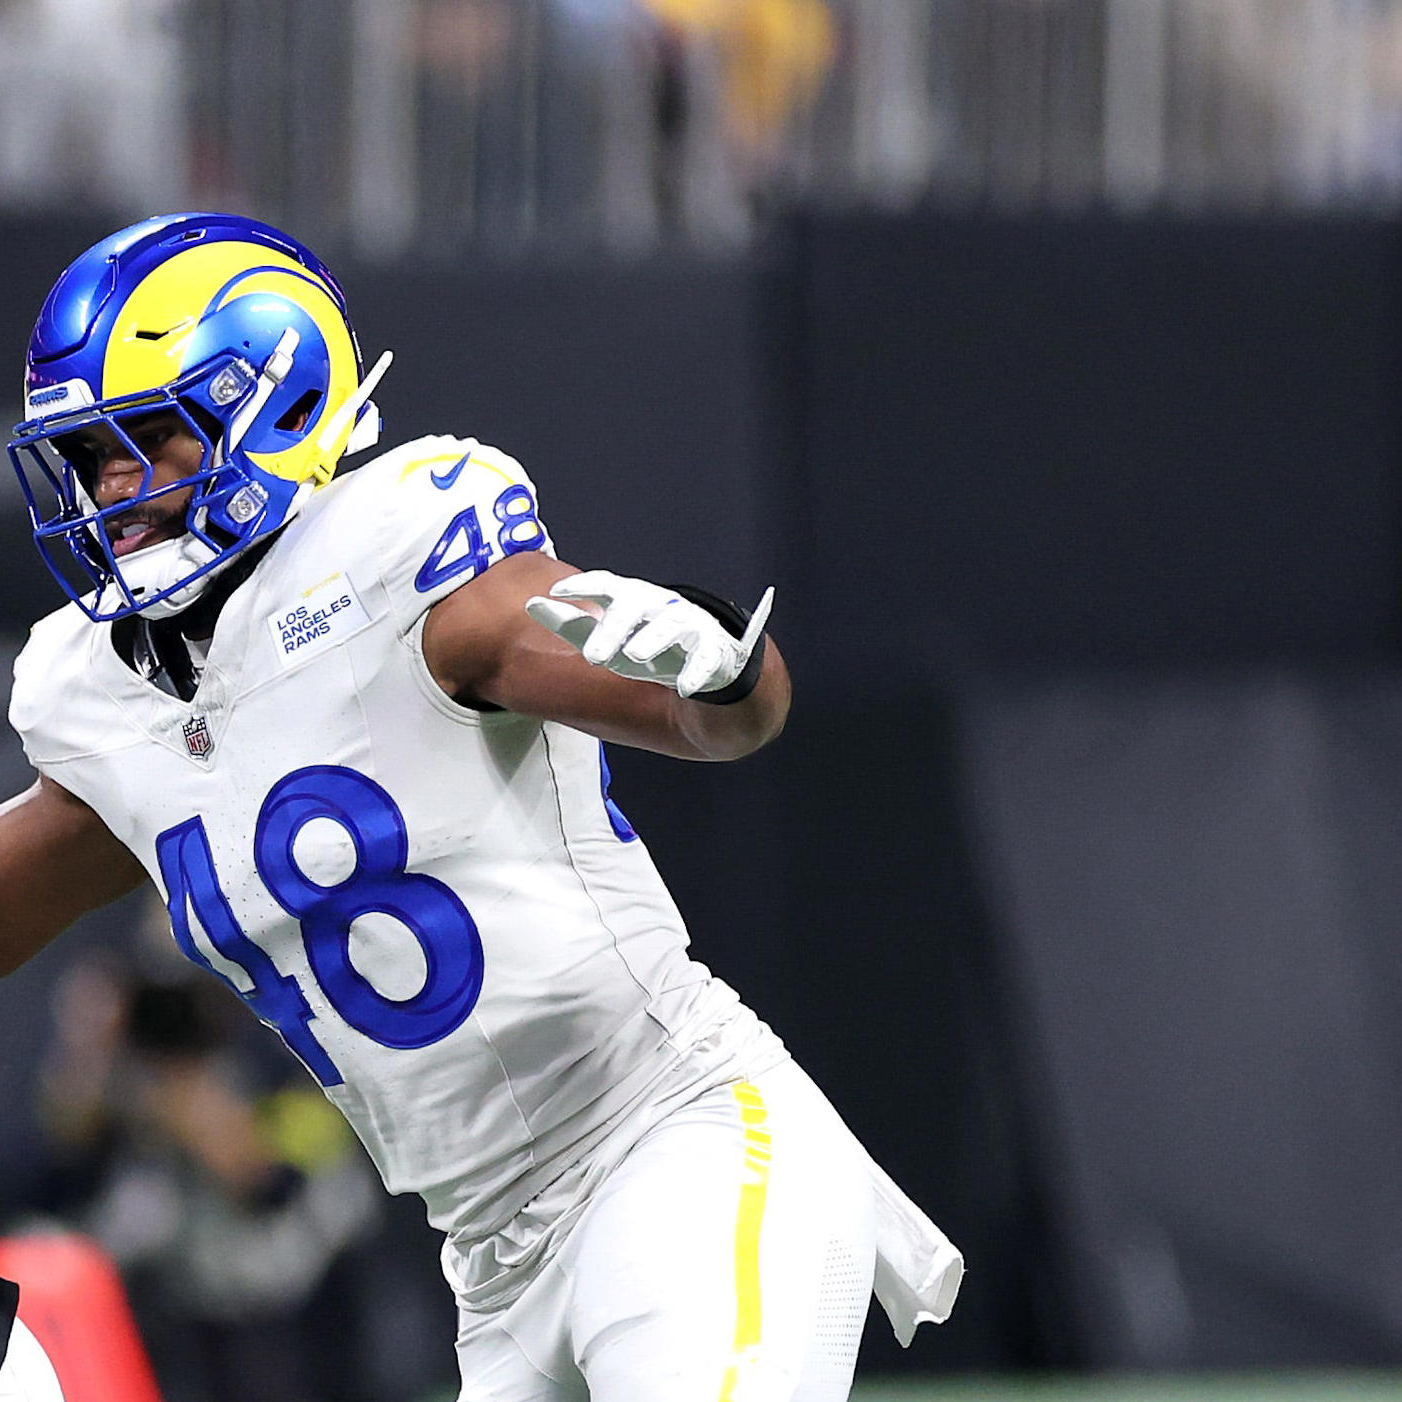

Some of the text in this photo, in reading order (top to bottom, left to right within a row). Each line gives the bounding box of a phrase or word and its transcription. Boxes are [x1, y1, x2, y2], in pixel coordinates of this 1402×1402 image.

[414, 484, 546, 593] 48
[277, 606, 308, 631] LOS
[282, 595, 352, 643] ANGELES
[284, 622, 331, 654] RAMS
[156, 764, 484, 1087] 48
